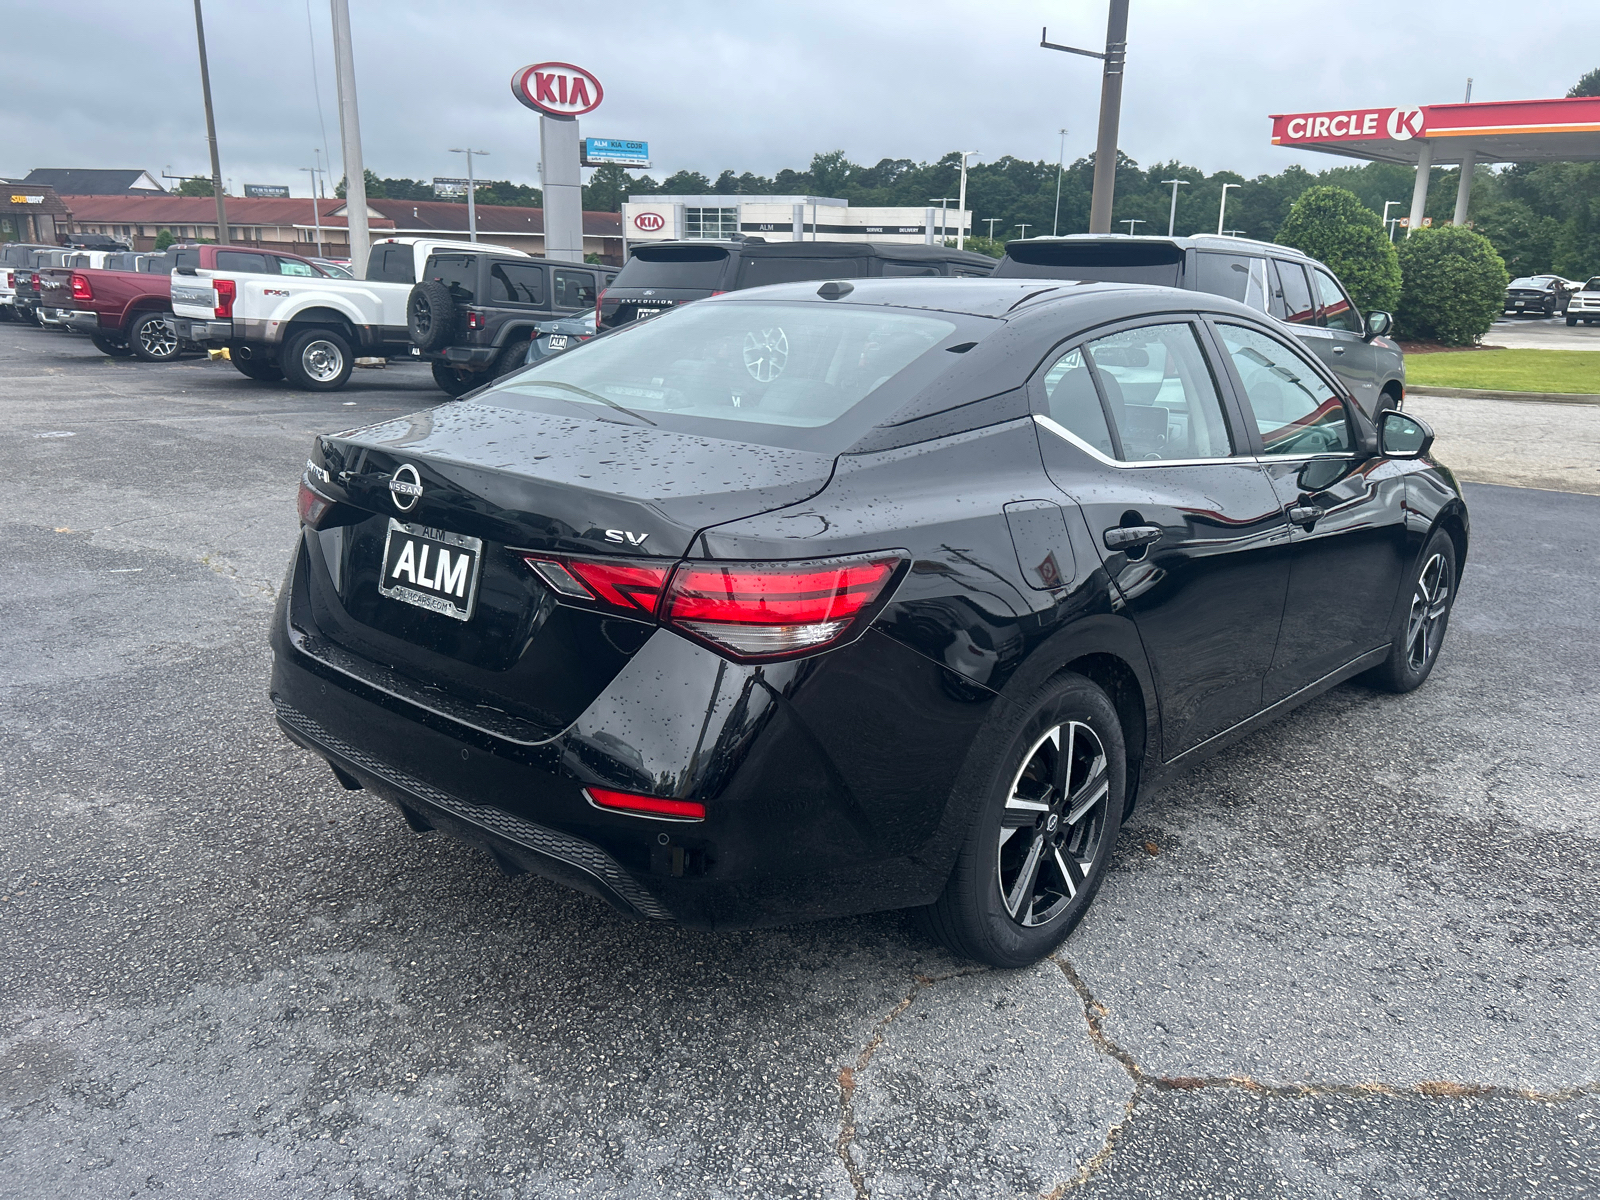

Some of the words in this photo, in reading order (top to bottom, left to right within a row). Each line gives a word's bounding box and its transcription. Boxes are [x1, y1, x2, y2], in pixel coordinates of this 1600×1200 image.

[534, 72, 591, 107] KIA
[1287, 113, 1379, 139] CIRCLE
[1395, 111, 1420, 138] K
[626, 142, 643, 150] CDJR
[11, 195, 45, 204] SUBWAY
[639, 216, 661, 228] KIA
[759, 223, 774, 231] ALM
[551, 338, 566, 347] ALM
[389, 481, 422, 496] NISSAN
[422, 526, 446, 542] ALM
[604, 529, 650, 547] SV
[391, 540, 470, 598] ALM
